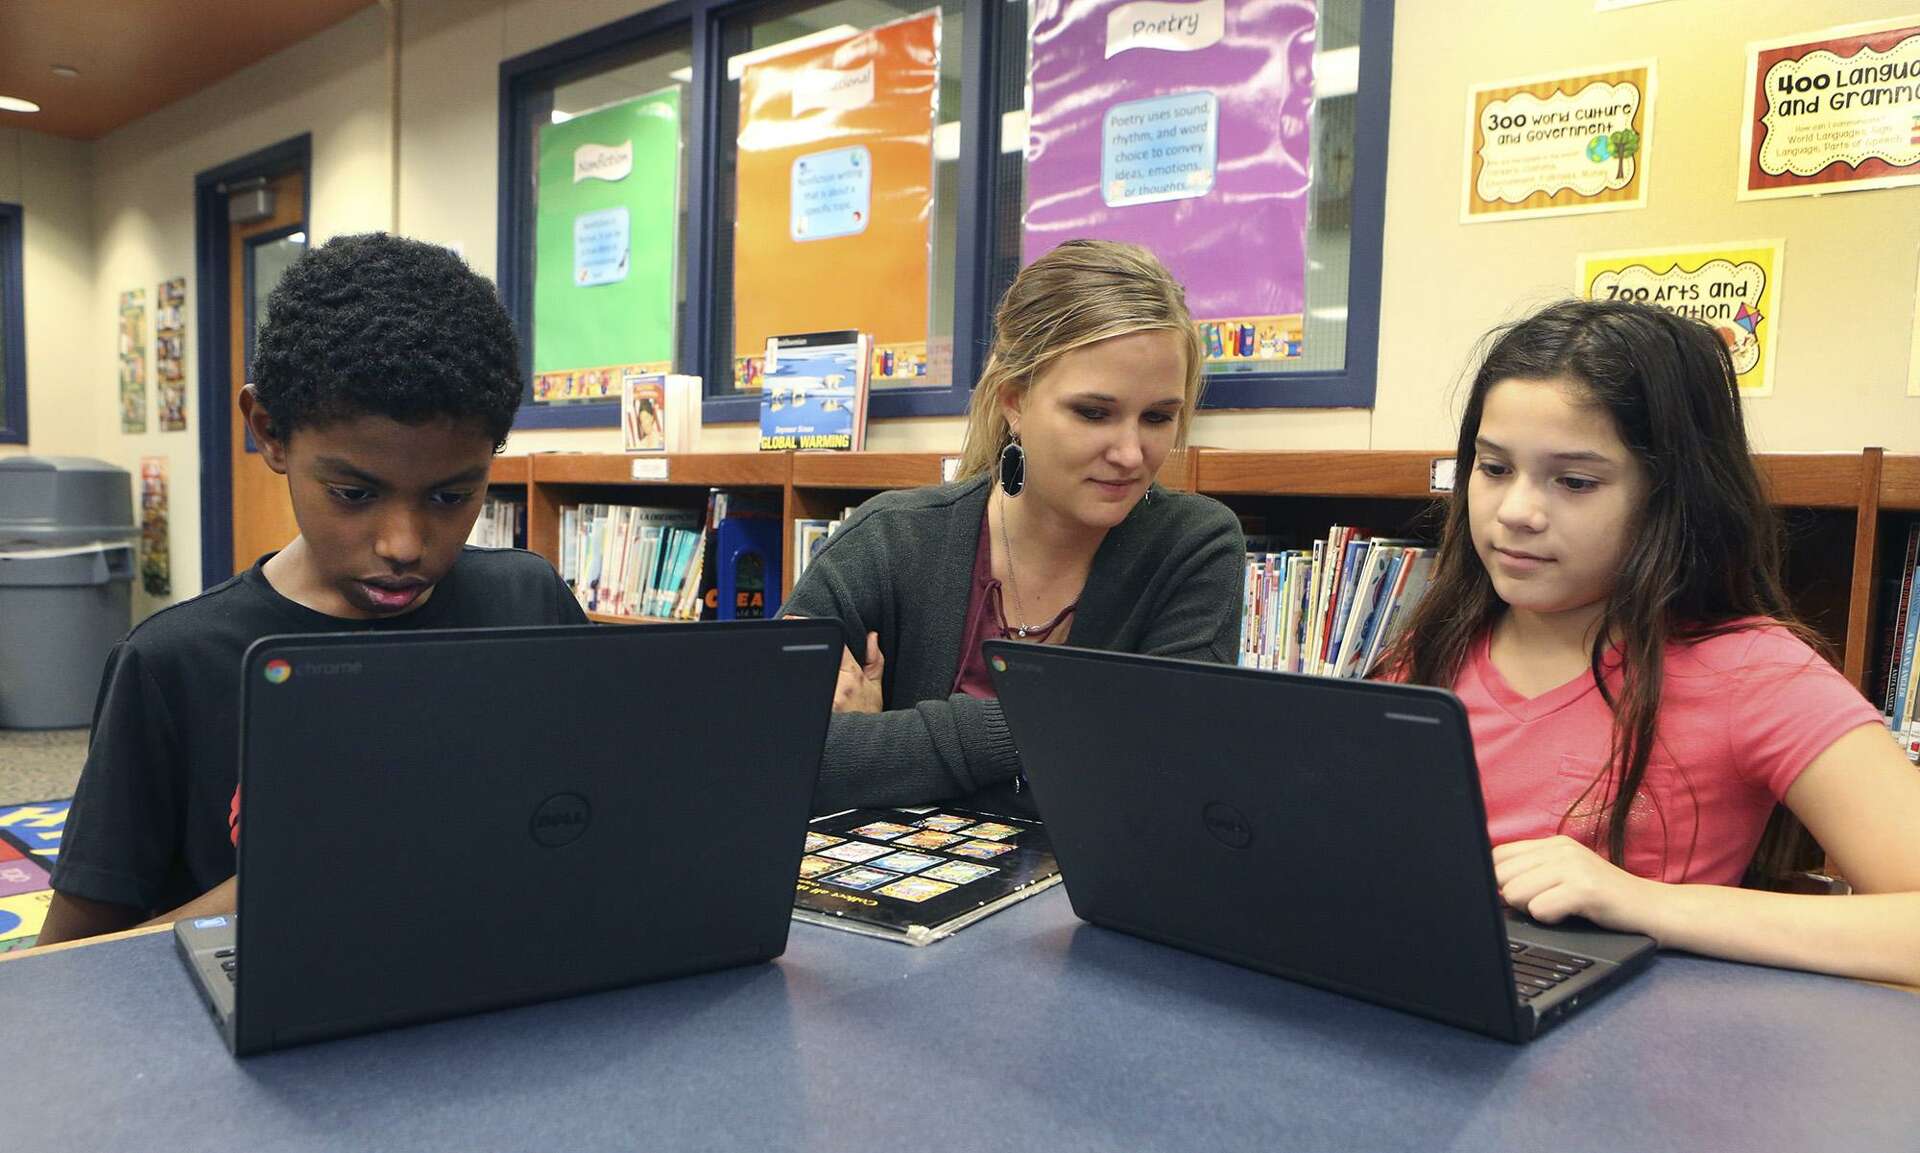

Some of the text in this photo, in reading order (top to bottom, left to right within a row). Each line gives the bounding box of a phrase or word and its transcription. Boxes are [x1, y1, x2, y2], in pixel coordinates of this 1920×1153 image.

[1132, 12, 1199, 38] Poetry
[1777, 74, 1830, 95] 400
[1778, 96, 1819, 117] and
[1111, 113, 1146, 127] Poetry
[1147, 109, 1171, 122] uses
[1487, 103, 1632, 131] 300 World Culture
[1156, 125, 1177, 139] and
[1179, 121, 1208, 135] word
[1497, 121, 1614, 146] and Government
[1787, 132, 1815, 145] World
[1114, 142, 1204, 163] choice to convey
[1124, 187, 1137, 198] or
[1606, 281, 1748, 301] 700 Arts and
[761, 434, 849, 450] GLOBAL WARMING
